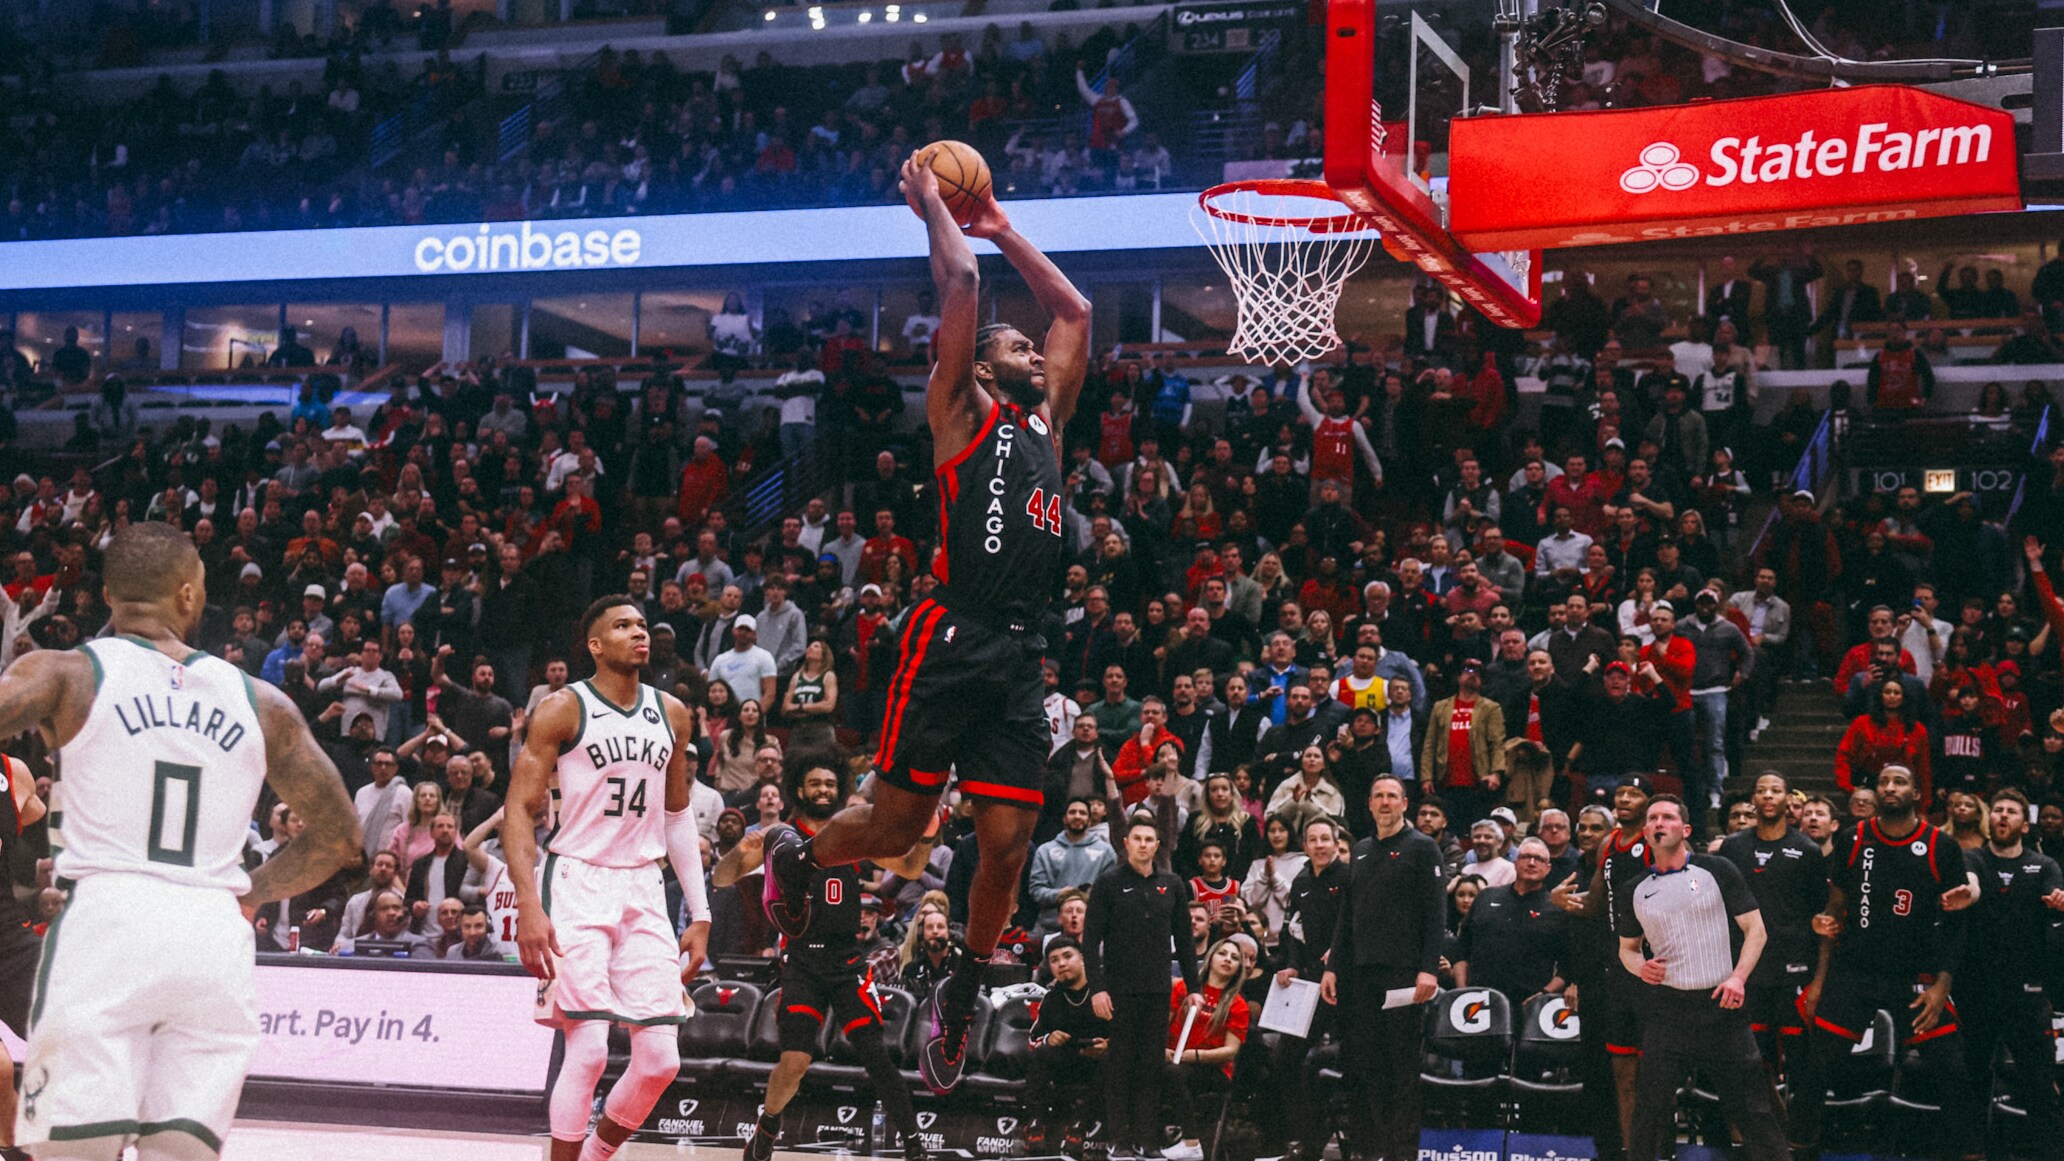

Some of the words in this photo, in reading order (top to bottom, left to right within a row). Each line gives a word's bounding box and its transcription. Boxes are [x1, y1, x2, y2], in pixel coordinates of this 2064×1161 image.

[1706, 130, 1848, 187] State
[1852, 122, 1993, 175] Farm
[1641, 221, 1777, 239] State
[1784, 209, 1917, 229] Farm
[414, 220, 642, 272] coinbase
[984, 424, 1014, 553] CHICAGO
[1927, 472, 1953, 489] EXIT
[1971, 470, 2013, 490] 102
[1026, 487, 1062, 537] 44
[114, 694, 245, 753] LILLARD
[1452, 720, 1471, 730] ULL
[586, 736, 669, 772] BUCKS
[1944, 735, 1981, 757] BULLS
[147, 759, 203, 867] 0
[603, 777, 647, 818] 34
[825, 878, 842, 905] 0
[1860, 847, 1874, 928] CHICAGO
[1892, 888, 1913, 916] 3
[314, 1009, 371, 1045] Pay
[376, 1010, 404, 1041] in
[412, 1014, 440, 1043] 4.
[658, 1118, 704, 1129] FANDUEL
